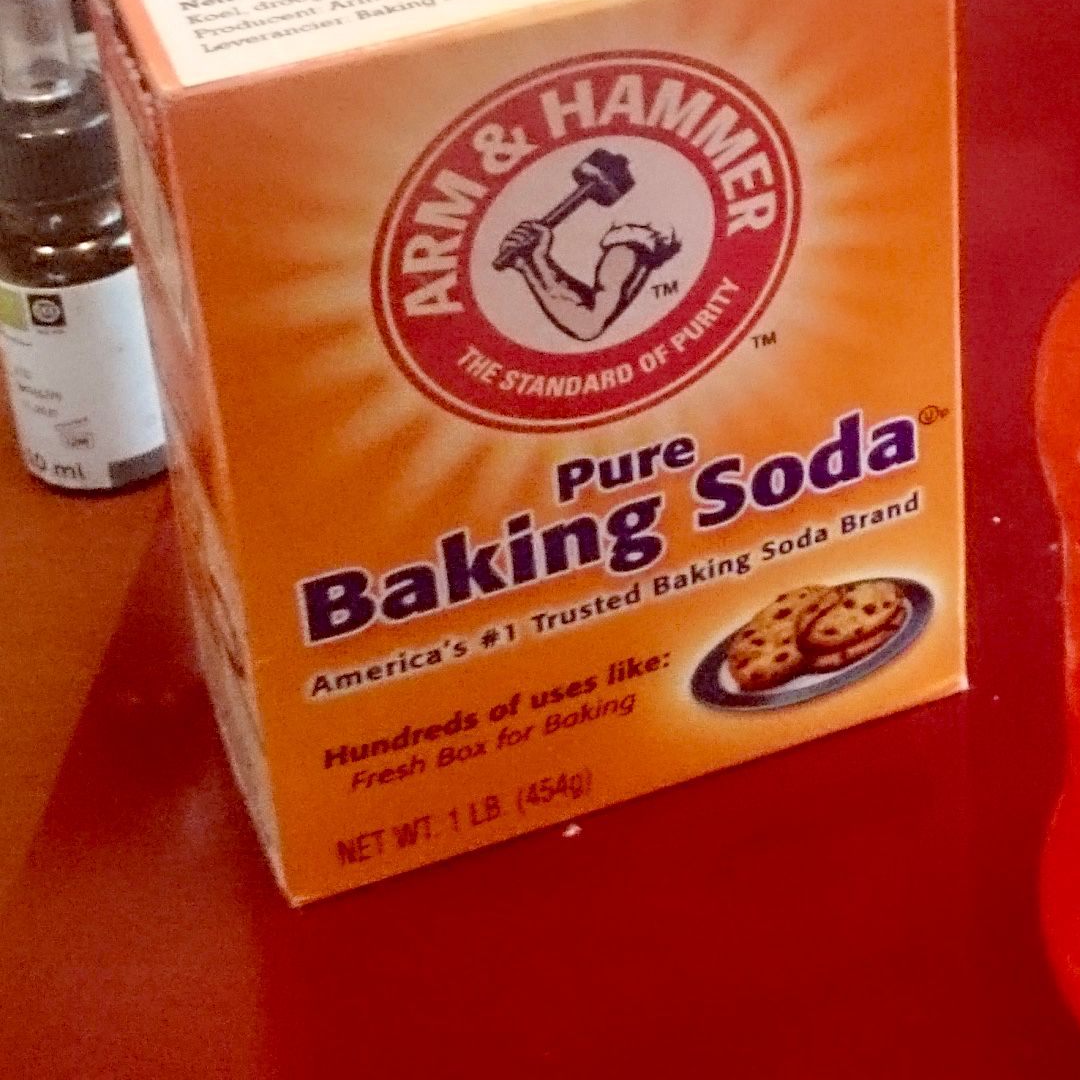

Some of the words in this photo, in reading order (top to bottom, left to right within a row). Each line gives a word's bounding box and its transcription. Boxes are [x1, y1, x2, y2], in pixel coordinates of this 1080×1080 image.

[402, 168, 490, 318] ARM
[472, 122, 541, 177] &
[538, 73, 779, 238] HAMMER
[455, 343, 502, 385] THE
[500, 363, 635, 398] STANDARD
[639, 342, 673, 373] OF
[672, 276, 742, 354] PURITY
[651, 280, 680, 301] TM
[751, 330, 778, 350] TM
[557, 436, 697, 503] Pure
[301, 496, 665, 644] Baking
[694, 411, 918, 528] Soda
[311, 637, 467, 697] America's
[480, 621, 517, 650] #1
[531, 585, 642, 635] Trusted
[653, 549, 751, 595] Baking
[762, 525, 829, 562] Soda
[840, 492, 920, 536] Brand
[324, 710, 479, 770] Hundreds
[489, 691, 522, 723] of
[530, 674, 599, 711] uses
[606, 651, 672, 686] like:
[351, 753, 427, 792] Fresh
[436, 739, 488, 769] Box
[496, 724, 536, 751] for
[543, 692, 638, 737] Baking
[336, 828, 386, 867] NET
[515, 767, 594, 816] (454g)
